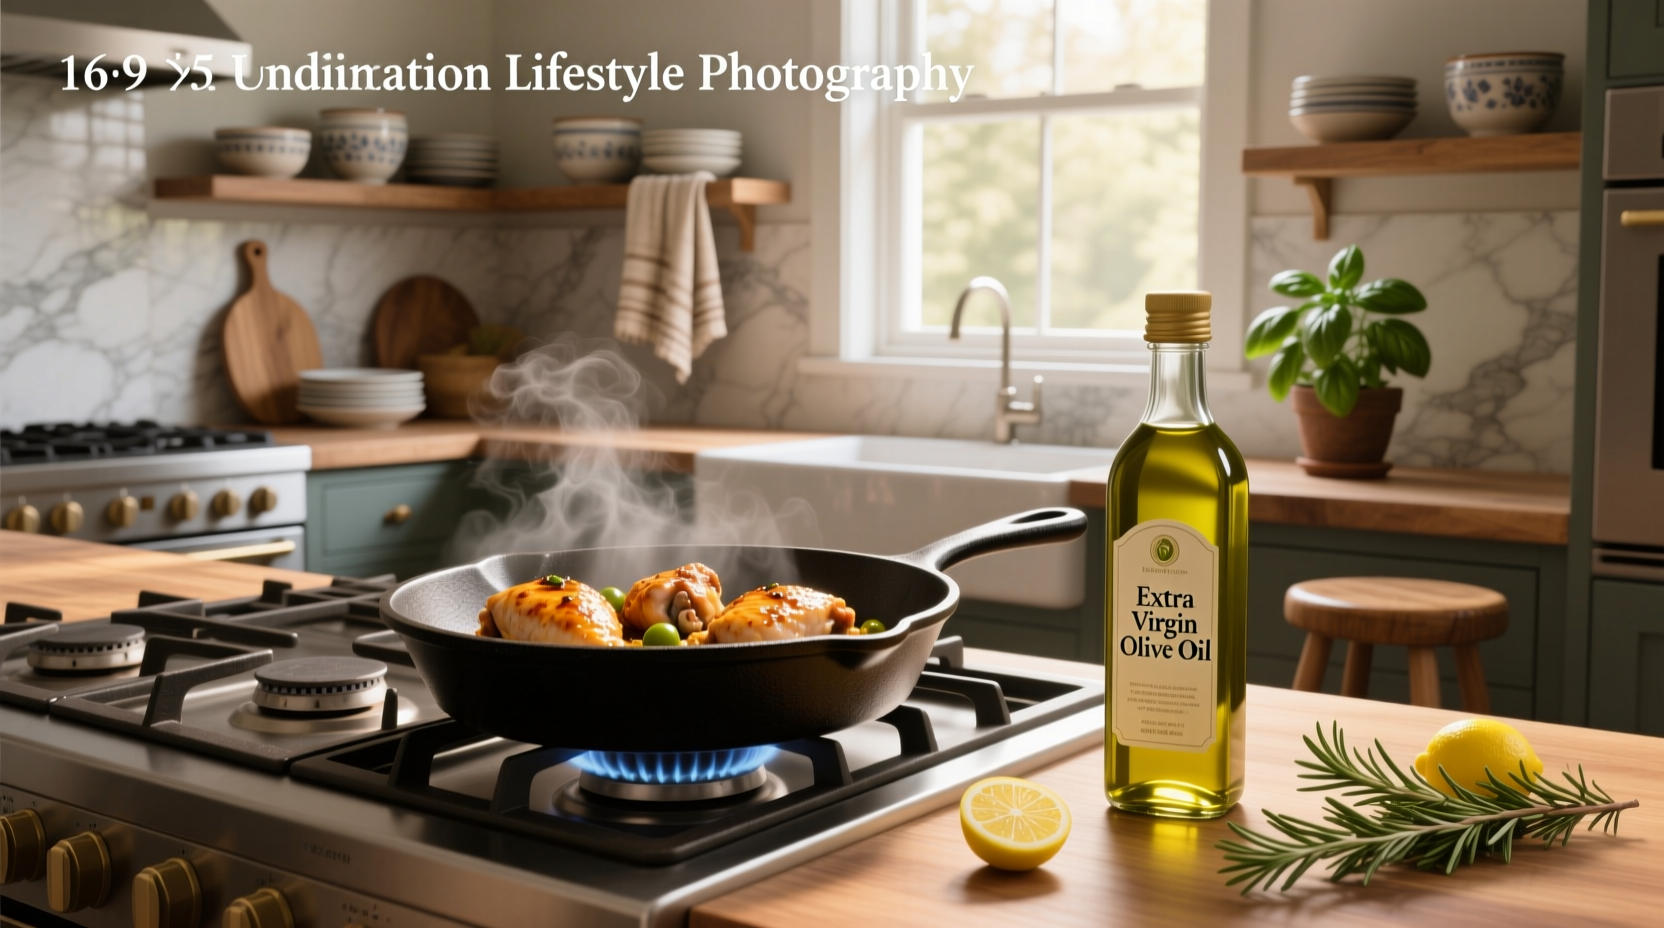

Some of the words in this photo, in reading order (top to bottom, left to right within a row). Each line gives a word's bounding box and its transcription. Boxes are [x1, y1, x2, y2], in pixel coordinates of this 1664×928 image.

[1136, 585, 1195, 609] Extra
[1131, 610, 1198, 640] Virgin
[1120, 635, 1173, 659] Olive
[1178, 638, 1211, 661] Oil
